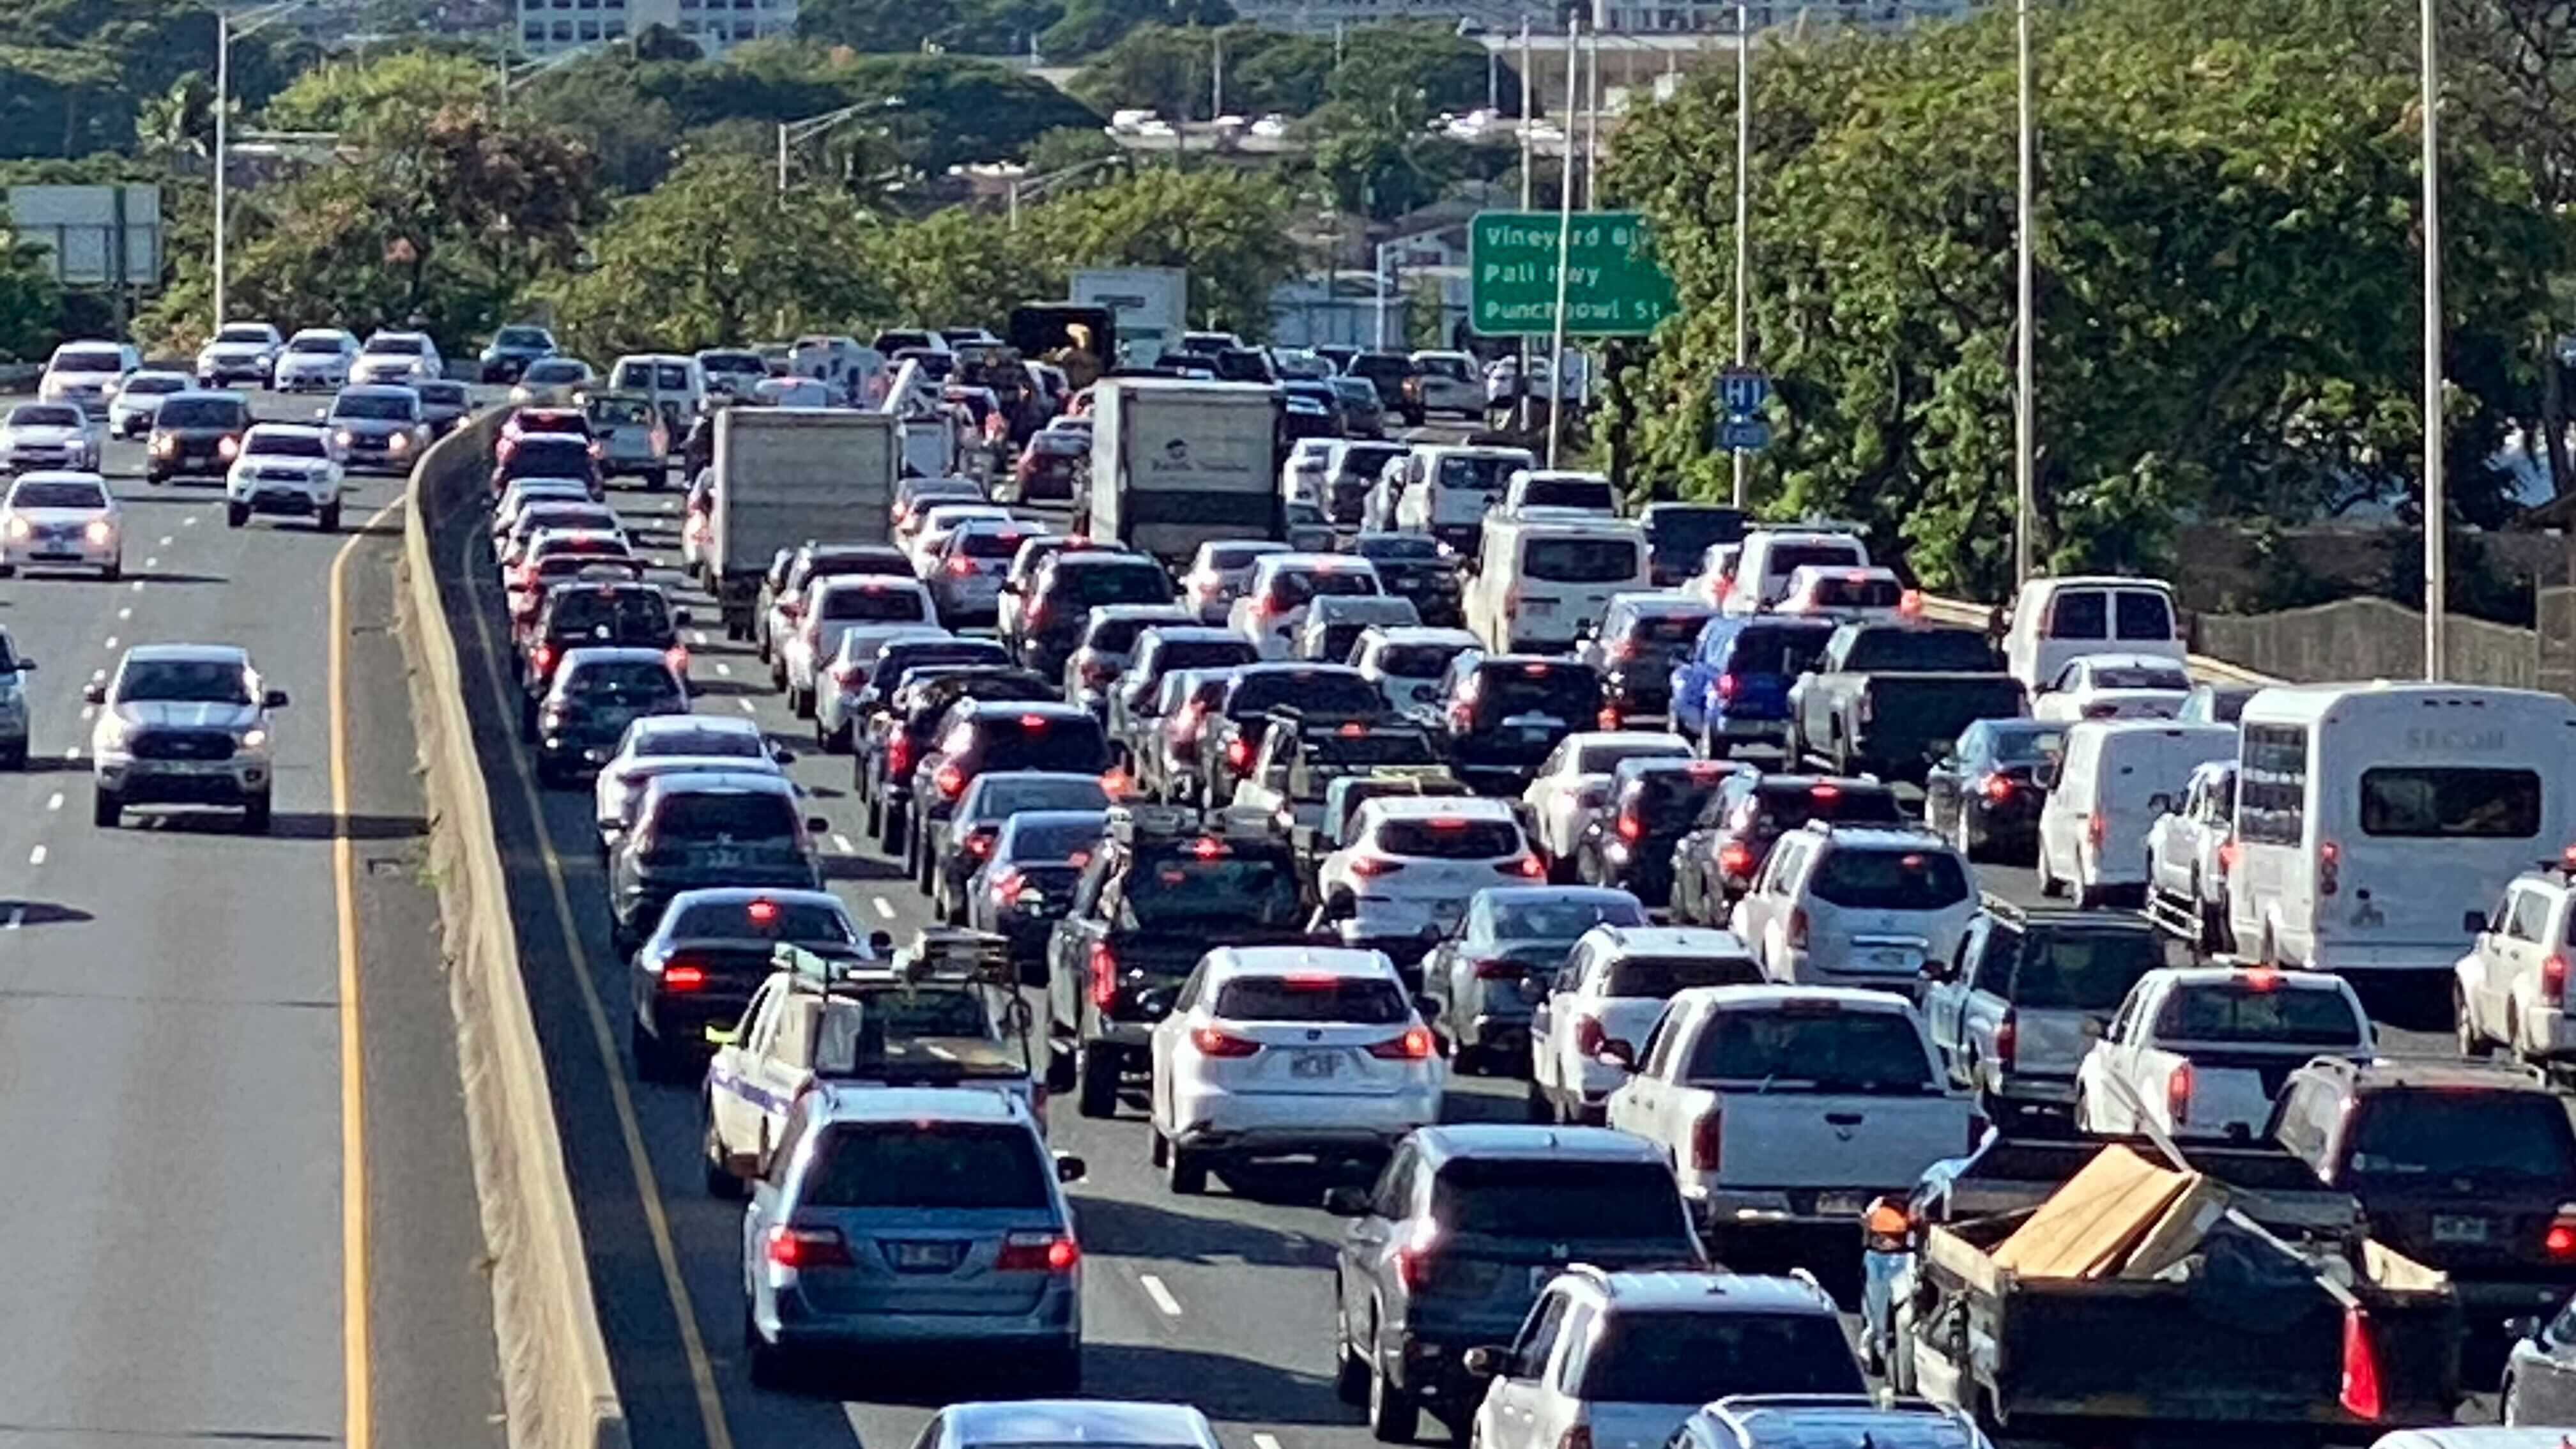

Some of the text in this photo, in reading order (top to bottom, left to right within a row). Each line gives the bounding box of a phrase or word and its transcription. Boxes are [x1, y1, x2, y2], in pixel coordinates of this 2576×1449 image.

[1612, 226, 1652, 246] Blv
[1484, 262, 1535, 282] Pali
[1634, 300, 1660, 319] St
